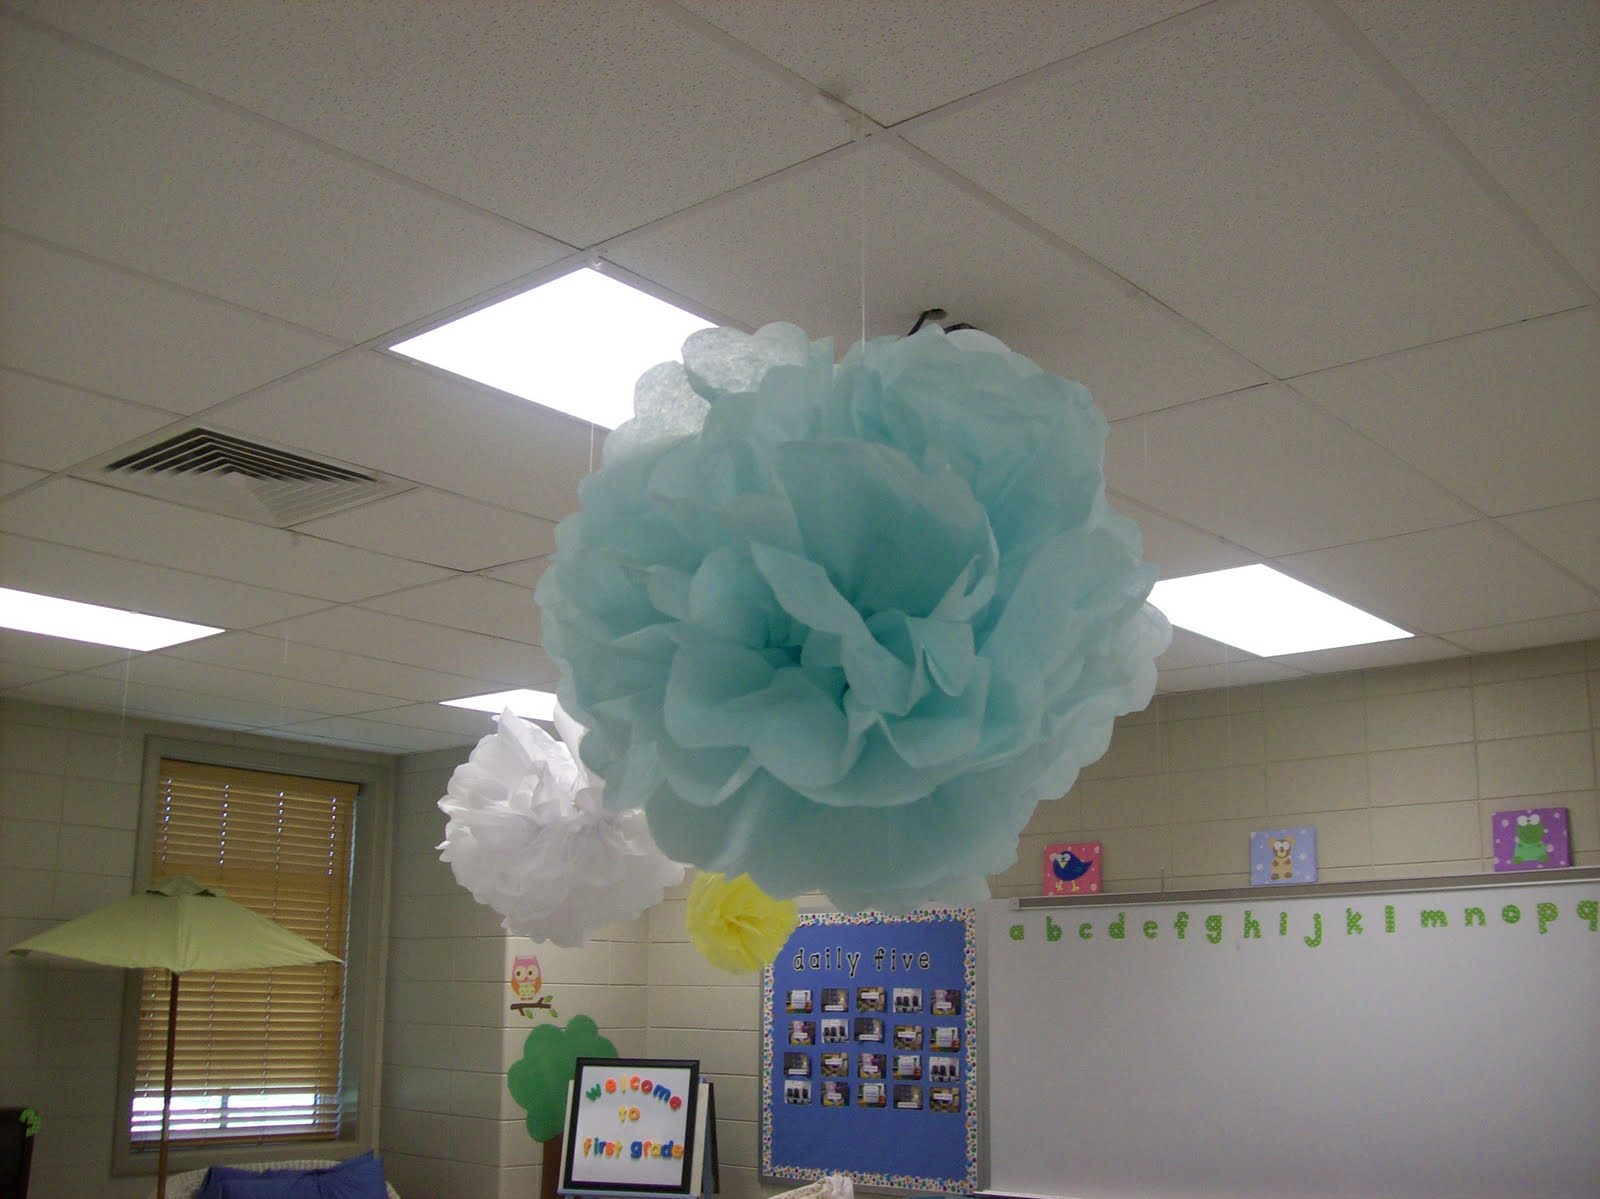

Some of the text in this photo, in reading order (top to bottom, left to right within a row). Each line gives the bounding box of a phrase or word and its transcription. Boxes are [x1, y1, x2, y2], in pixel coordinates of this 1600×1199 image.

[1009, 924, 1025, 941] a
[1046, 915, 1062, 942] b
[1078, 922, 1093, 940] c
[1108, 912, 1126, 940] d
[1143, 920, 1159, 939] e
[1174, 911, 1189, 940] f
[1205, 914, 1223, 945] g
[1244, 910, 1262, 939] h
[1303, 912, 1322, 948] j
[1346, 907, 1363, 935] k
[1385, 905, 1396, 933] l
[1420, 909, 1448, 928] m
[1464, 906, 1486, 927] n
[1502, 904, 1521, 924] o
[1536, 902, 1559, 934] p
[1576, 900, 1599, 932] q
[793, 946, 930, 978] daily five
[586, 1074, 682, 1111] welcome
[619, 1105, 640, 1122] to
[583, 1137, 683, 1160] first grade
